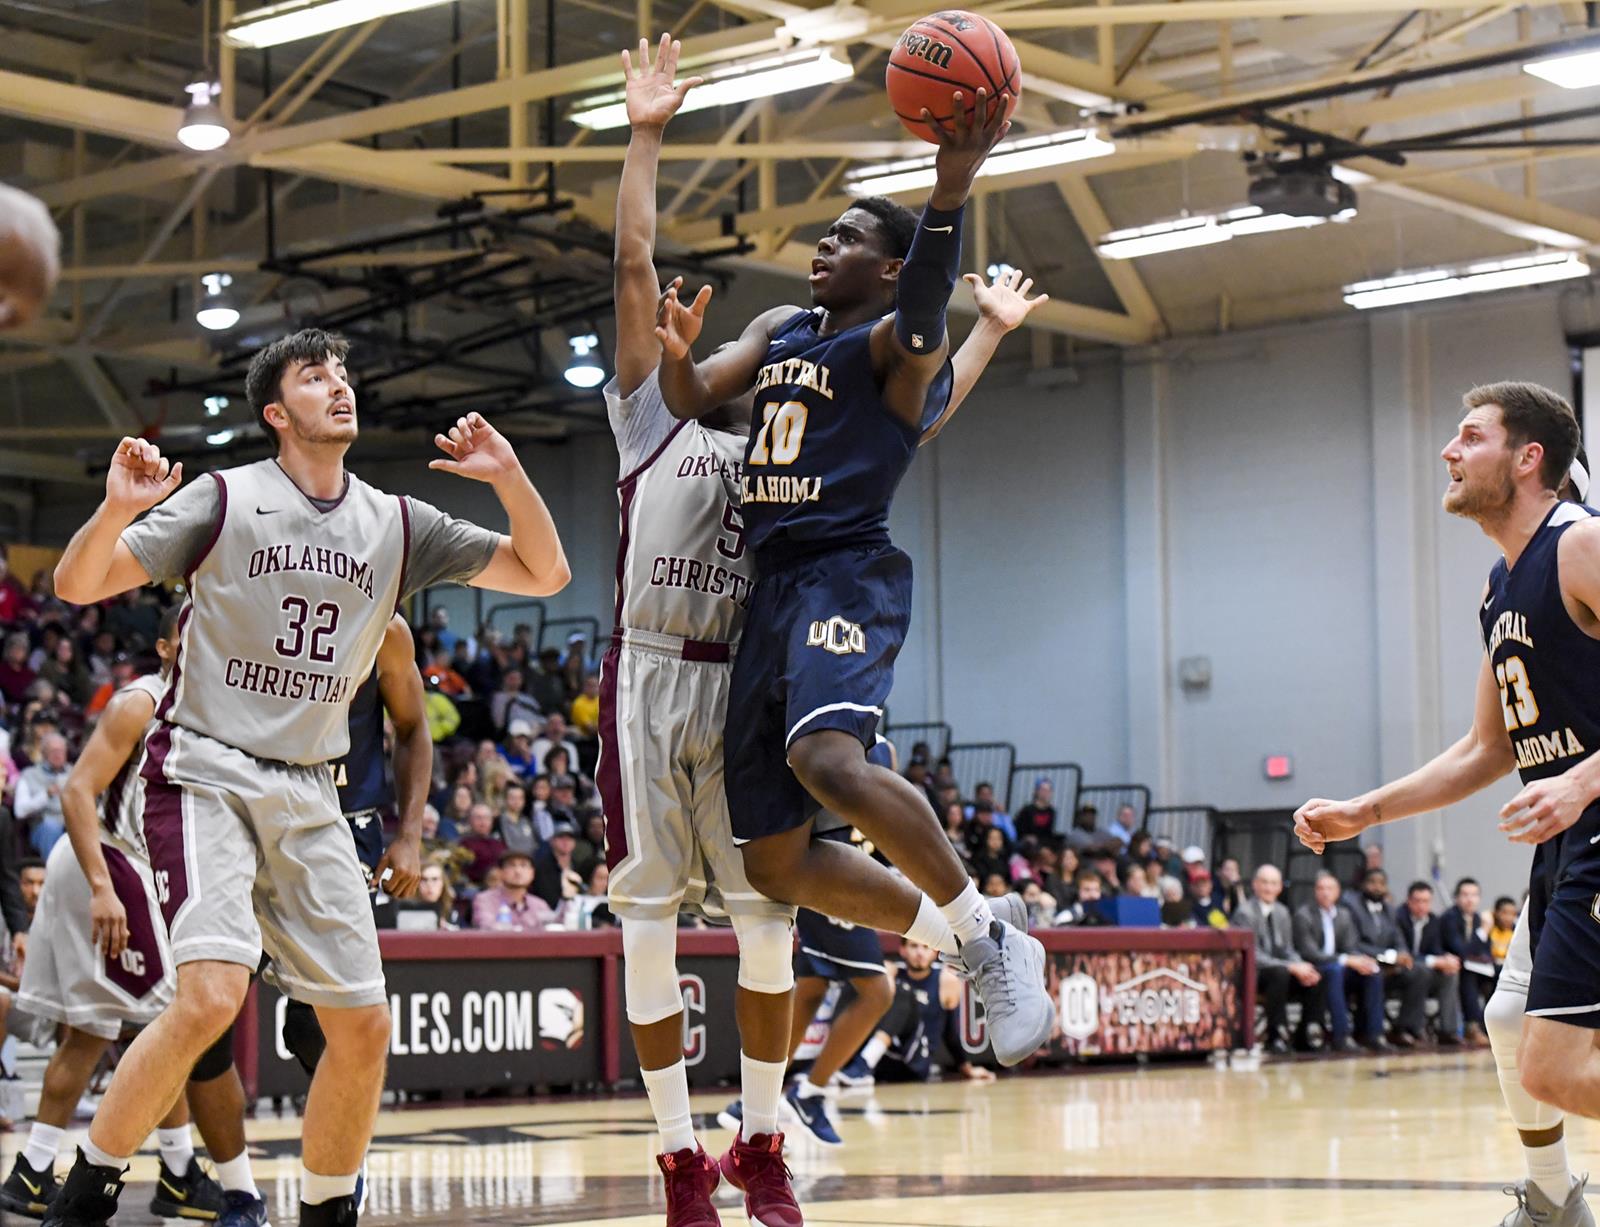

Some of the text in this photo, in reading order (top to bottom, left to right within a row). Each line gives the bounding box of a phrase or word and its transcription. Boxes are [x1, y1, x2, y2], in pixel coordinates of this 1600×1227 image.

[755, 357, 834, 400] CENTRAL
[749, 400, 809, 465] 10
[715, 500, 746, 562] 5
[248, 544, 375, 601] OKLAHOMA
[274, 594, 341, 665] 32
[1496, 655, 1540, 732] 23
[1515, 727, 1585, 769] AHOMA
[121, 948, 146, 977] OC
